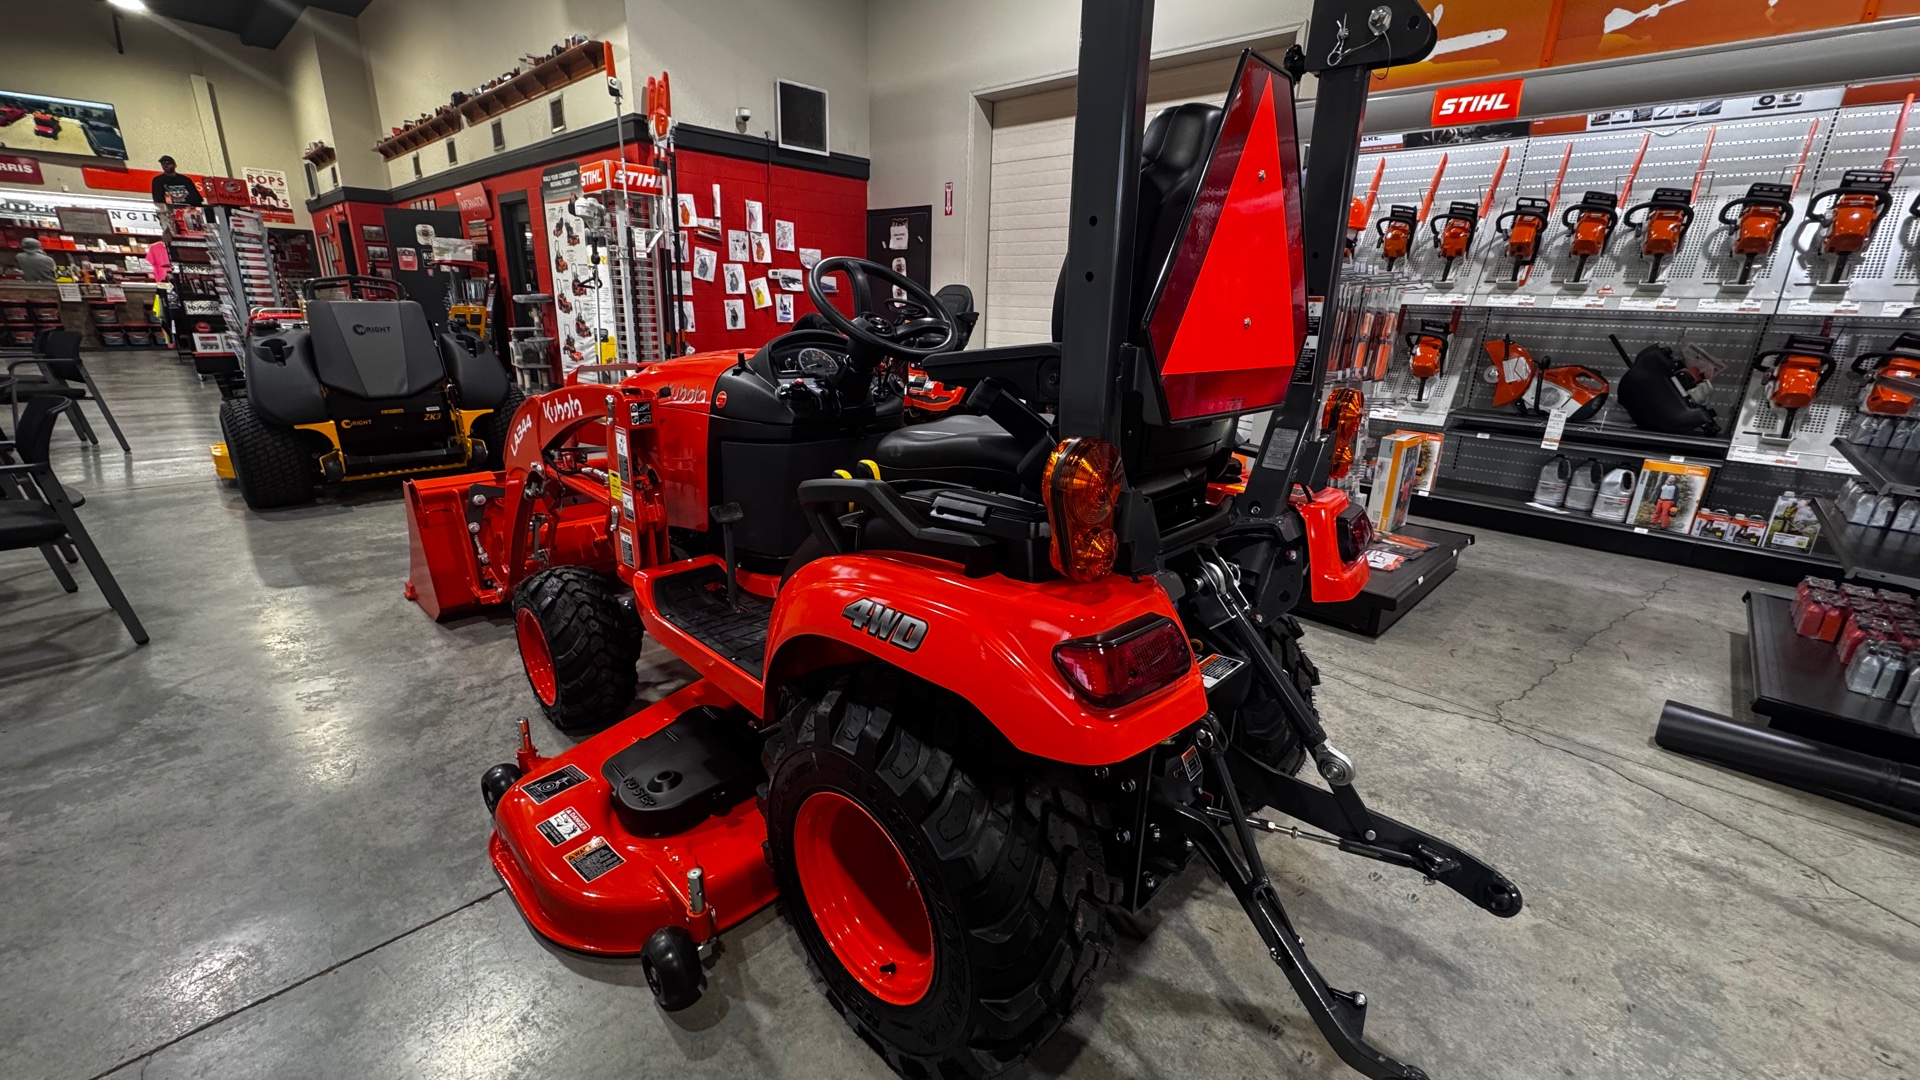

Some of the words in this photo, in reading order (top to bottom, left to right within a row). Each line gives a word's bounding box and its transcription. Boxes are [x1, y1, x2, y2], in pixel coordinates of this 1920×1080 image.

[1439, 93, 1510, 116] STIHL
[246, 174, 285, 186] ROPS
[581, 168, 602, 187] STIHL
[218, 193, 250, 203] Kubota
[250, 196, 290, 208] BELTS
[352, 324, 391, 336] WRIGHT
[543, 394, 583, 424] Kubota
[424, 412, 441, 421] ZK3
[341, 419, 373, 429] WRIGHT
[510, 413, 533, 457] LA344
[842, 597, 929, 652] 4WD
[623, 777, 640, 790] NO
[570, 811, 588, 831] DANGER
